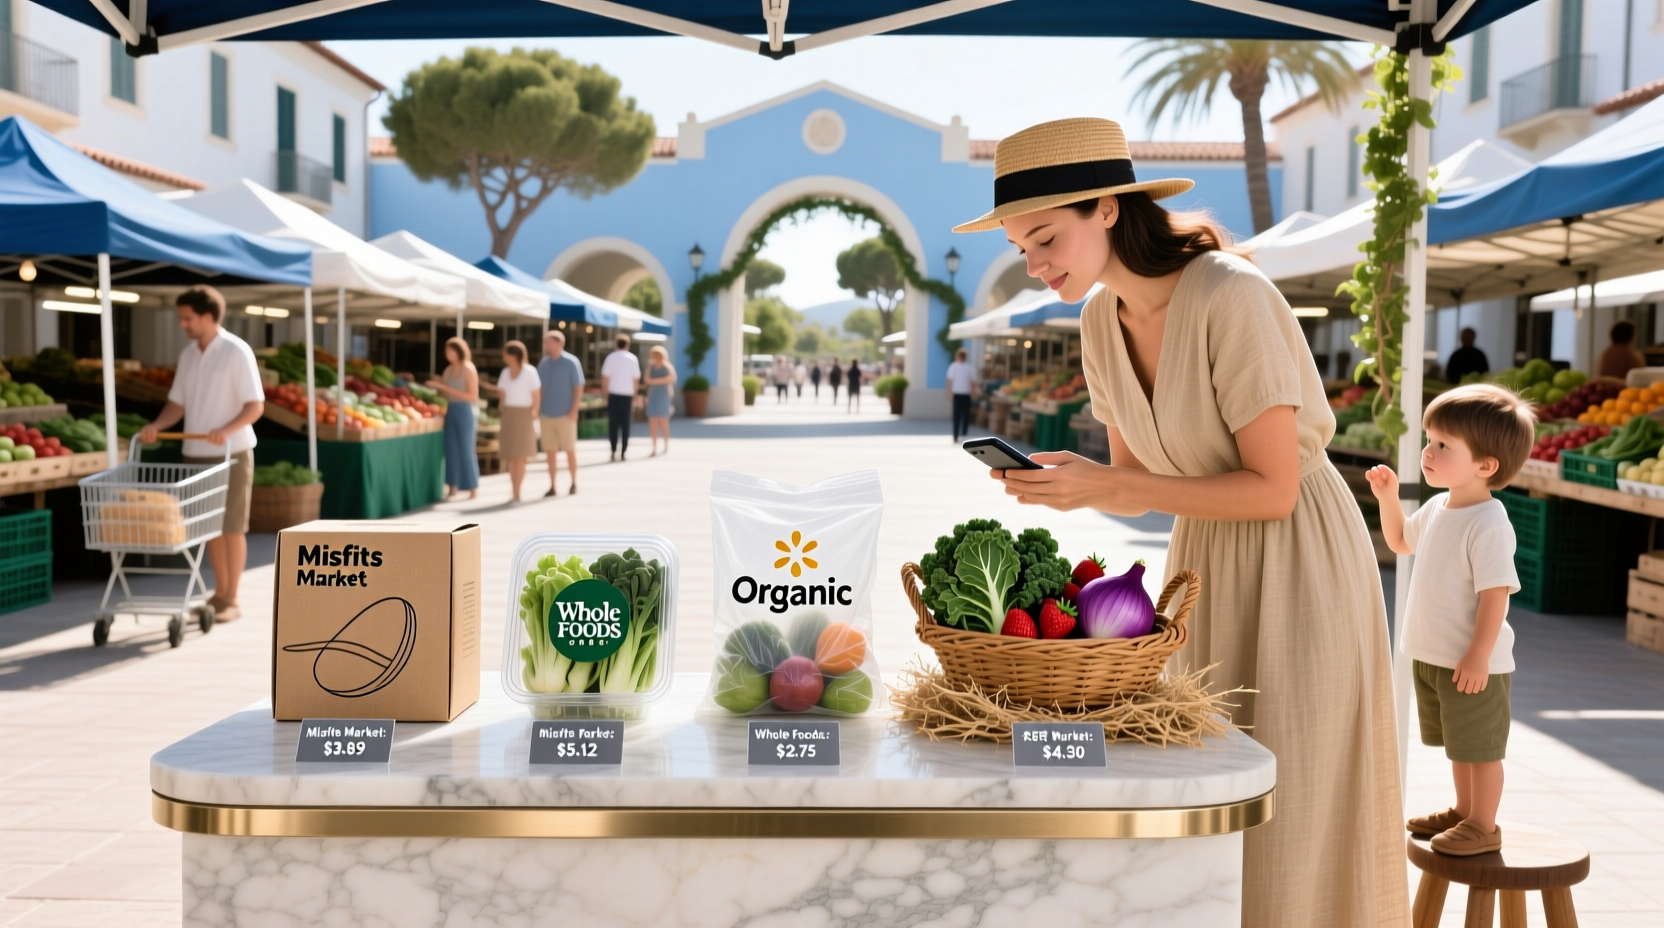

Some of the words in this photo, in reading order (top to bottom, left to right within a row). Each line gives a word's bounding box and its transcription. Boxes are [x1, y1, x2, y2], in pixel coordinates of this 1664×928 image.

[298, 544, 383, 567] Misfits
[297, 569, 368, 587] Market
[732, 575, 852, 613] Organic
[555, 601, 621, 622] Whole
[557, 622, 622, 639] FOODS
[557, 742, 598, 758] $5.12
[776, 743, 816, 759] $2.75
